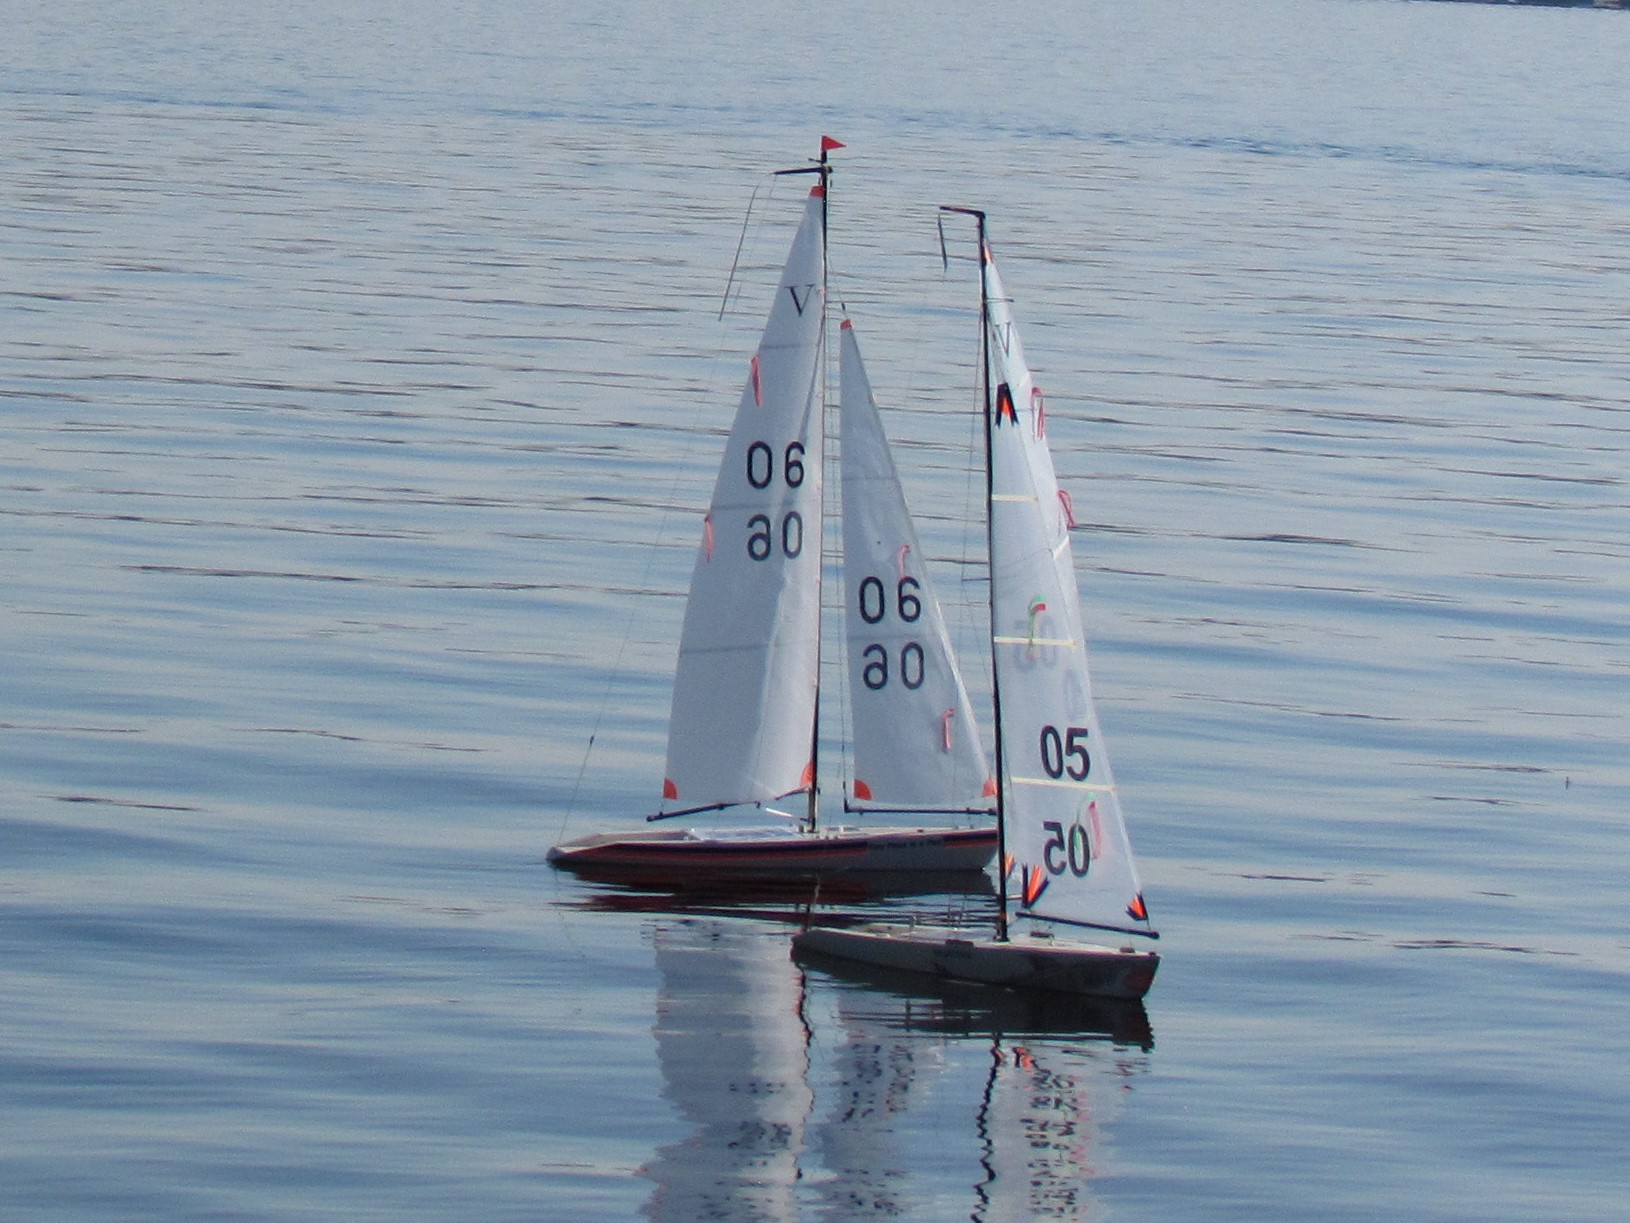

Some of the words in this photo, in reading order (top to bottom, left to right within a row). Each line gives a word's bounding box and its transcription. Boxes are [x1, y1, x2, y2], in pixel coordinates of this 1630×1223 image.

[785, 284, 813, 316] V
[745, 440, 806, 489] 06
[858, 575, 922, 624] 06
[1039, 724, 1091, 781] 05
